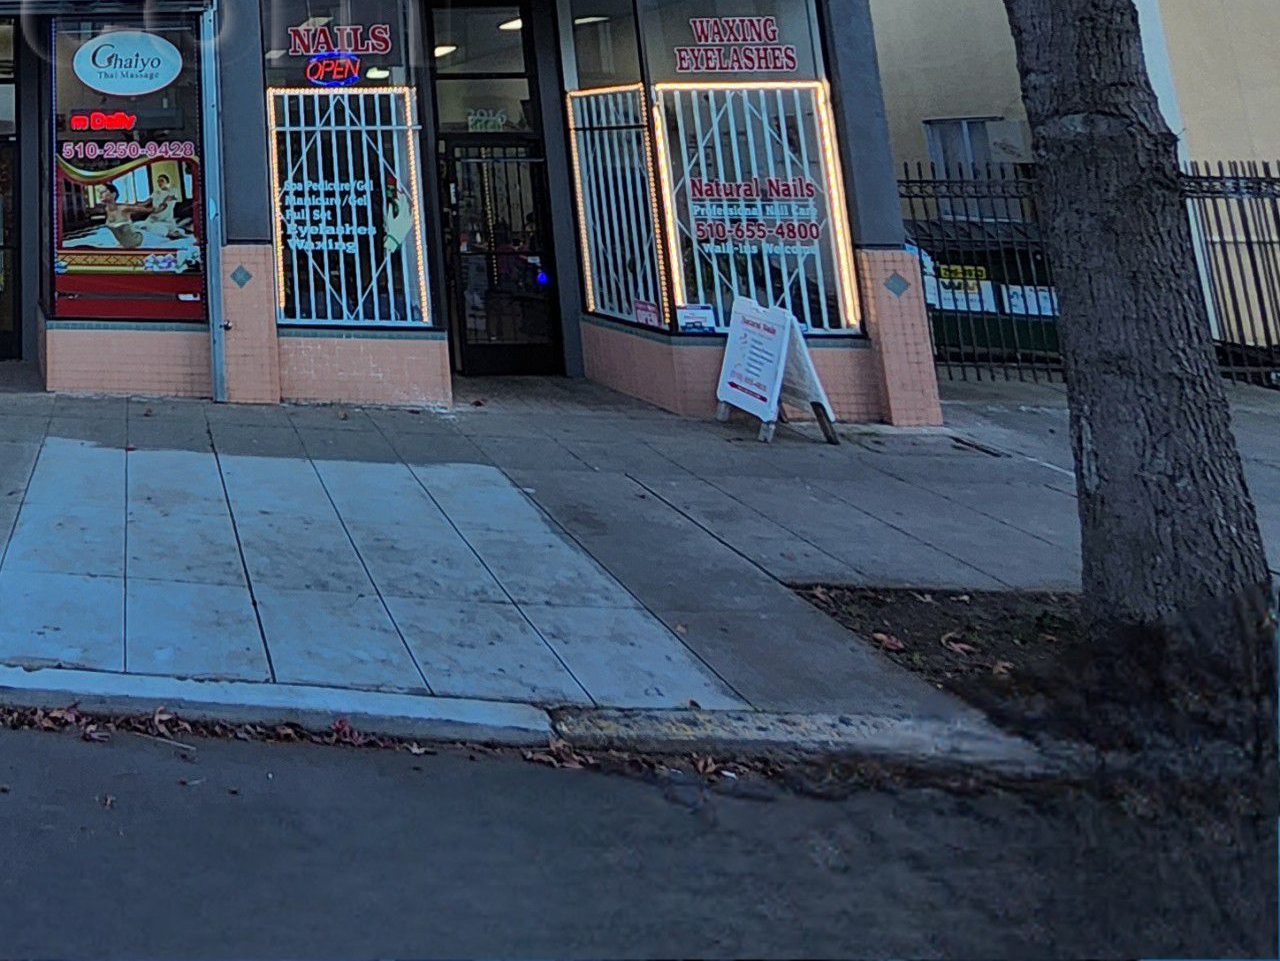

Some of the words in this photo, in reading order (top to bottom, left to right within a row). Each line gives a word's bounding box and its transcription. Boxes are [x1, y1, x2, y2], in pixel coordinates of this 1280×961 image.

[690, 16, 778, 44] WAXING
[288, 24, 391, 55] NAILS
[675, 45, 797, 72] EYELASHES
[97, 71, 118, 79] Thai
[121, 71, 160, 80] Massage
[306, 58, 360, 80] OPEN
[62, 141, 196, 159] 510-250-9428
[284, 180, 303, 192] Spa
[689, 177, 761, 198] Natural
[766, 177, 816, 198] Nails
[285, 209, 306, 220] Full
[312, 209, 332, 220] Set
[692, 204, 761, 216] Professional
[765, 204, 789, 216] Nail
[793, 205, 818, 216] Care
[287, 224, 377, 237] Eyelashes
[695, 221, 821, 240] 510-655-4800
[287, 239, 357, 253] Waxing
[703, 243, 758, 254] Walk-ins
[763, 243, 818, 254] Welcome
